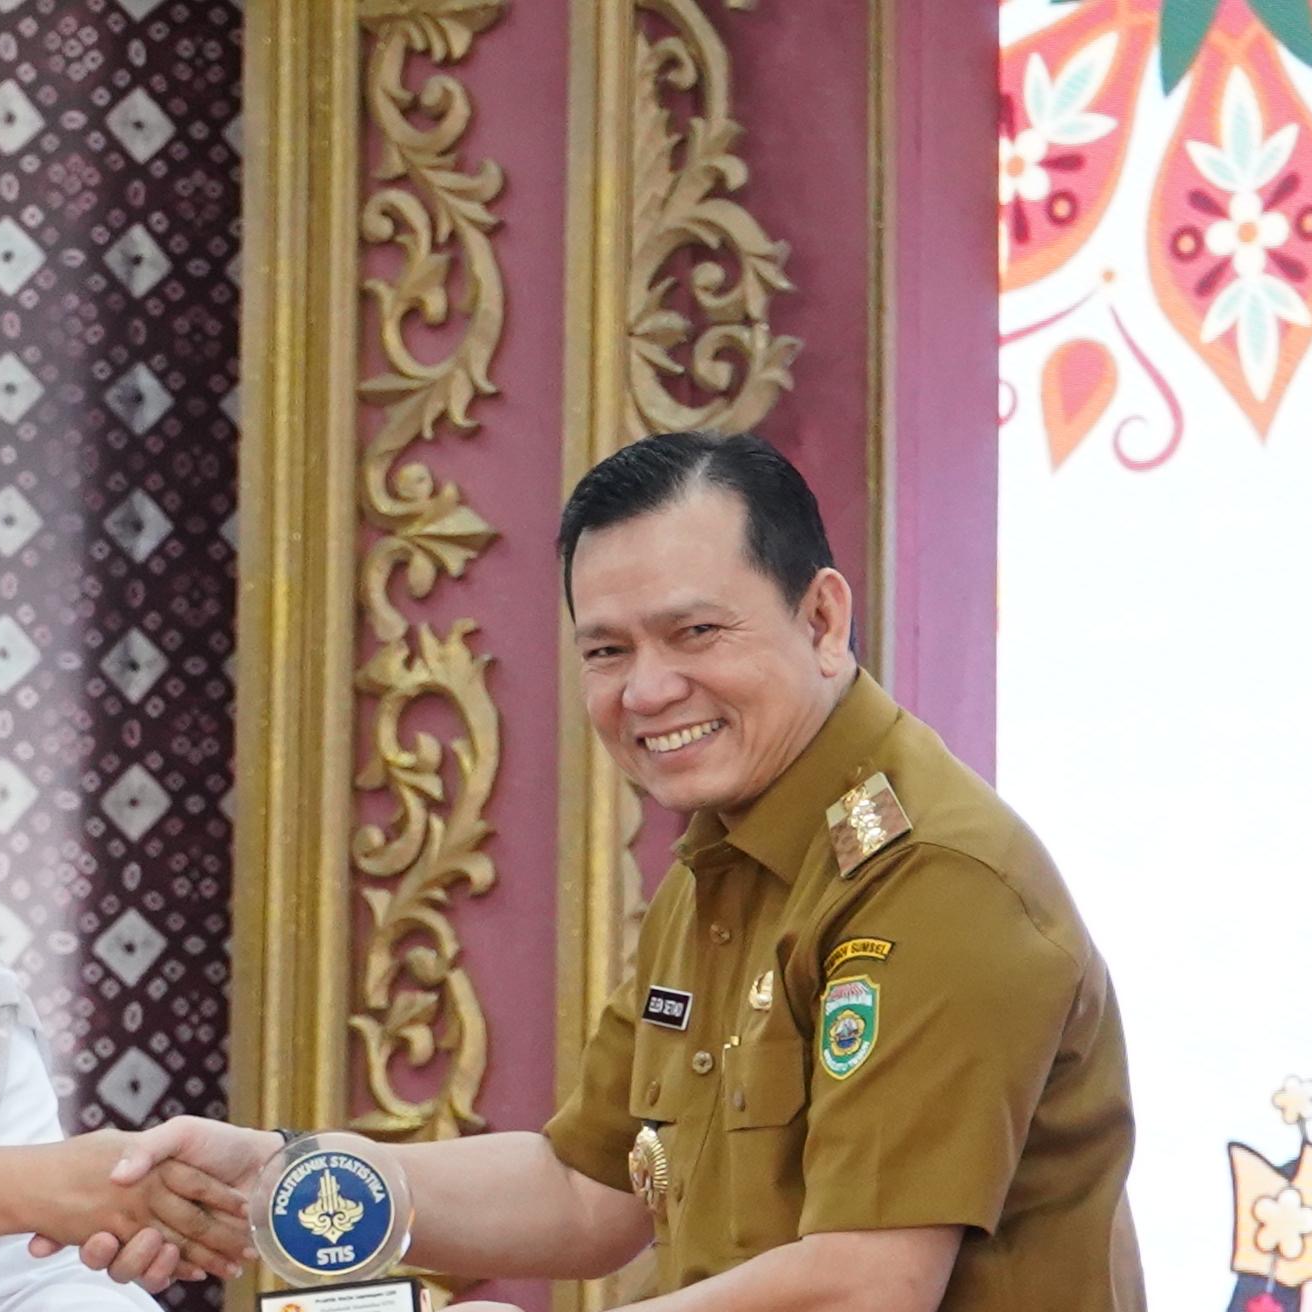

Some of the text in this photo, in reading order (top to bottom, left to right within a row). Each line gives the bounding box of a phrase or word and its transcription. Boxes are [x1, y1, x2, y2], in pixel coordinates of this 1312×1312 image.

[275, 1156, 386, 1215] POLITEKNIK STATISTIKA
[316, 1245, 355, 1265] STIS
